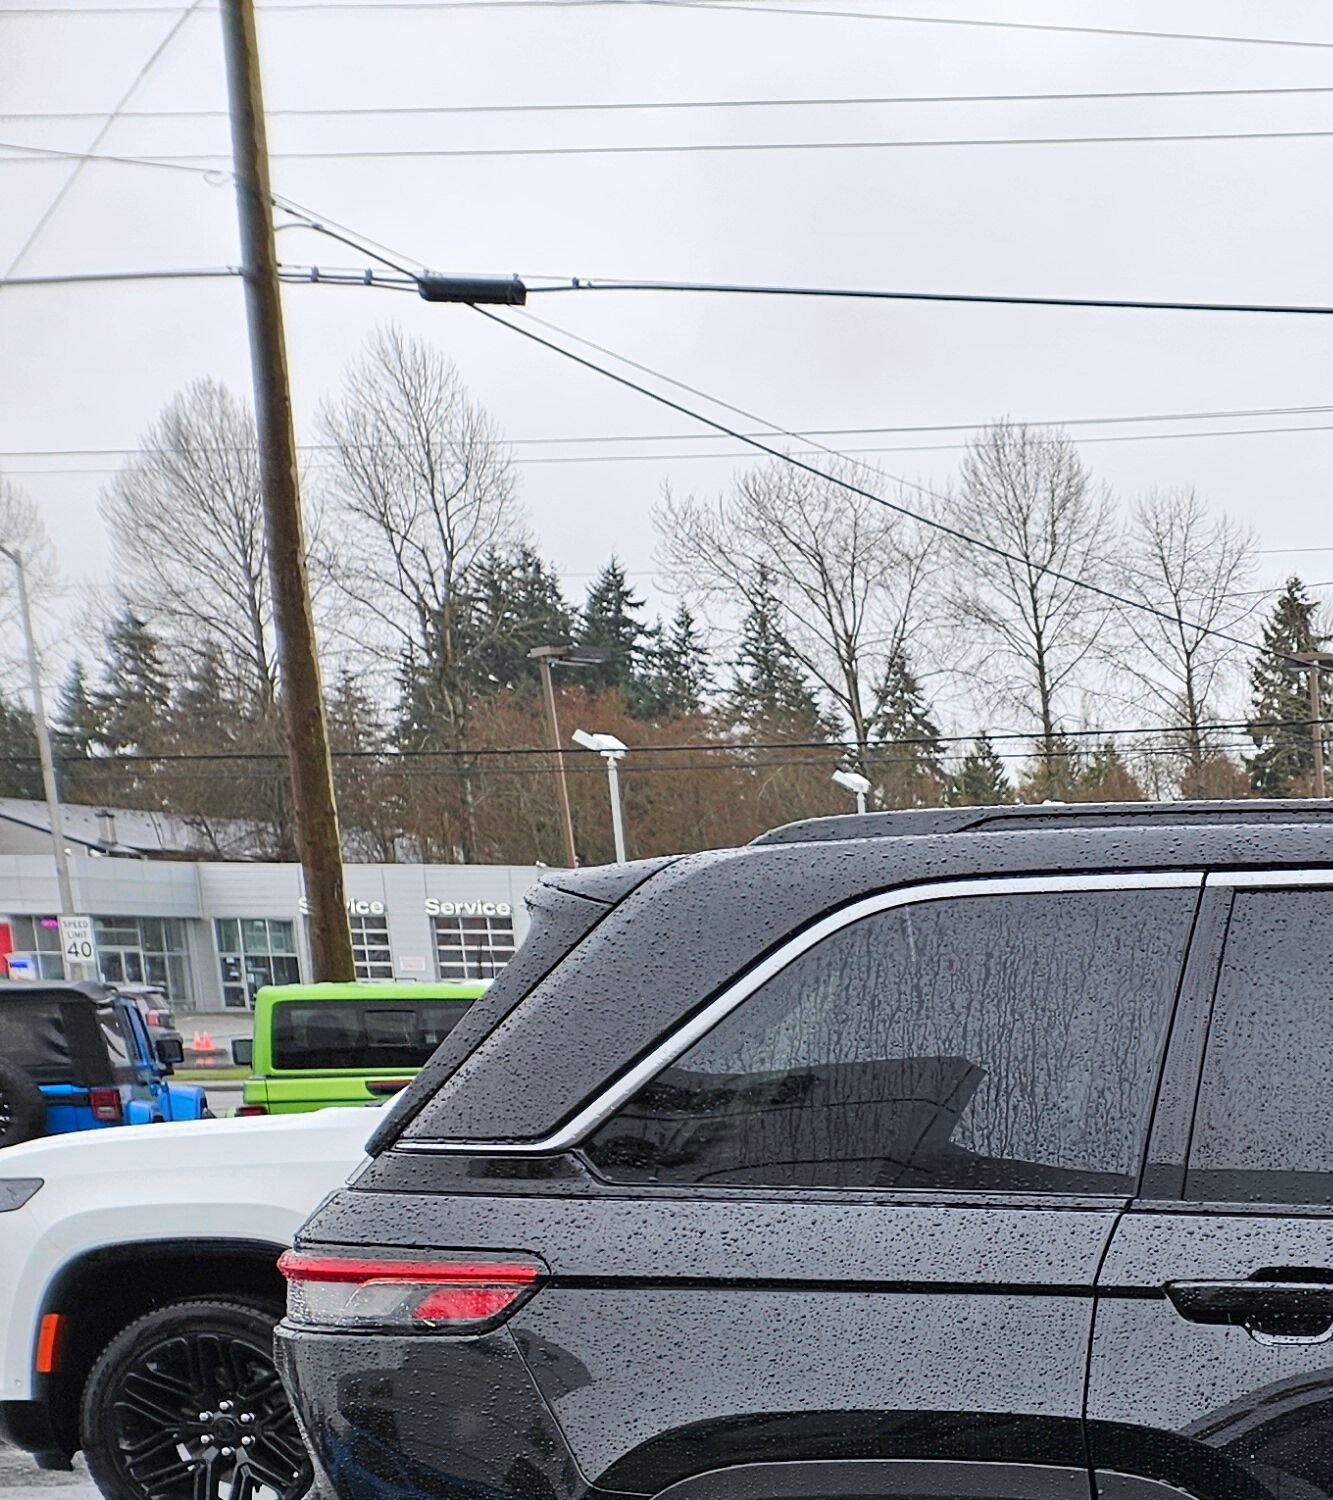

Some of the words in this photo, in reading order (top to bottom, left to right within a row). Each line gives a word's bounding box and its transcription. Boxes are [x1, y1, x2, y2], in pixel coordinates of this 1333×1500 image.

[425, 898, 511, 916] Service
[63, 920, 88, 928] SPEED
[67, 931, 87, 939] LIMIT
[68, 941, 91, 957] 40
